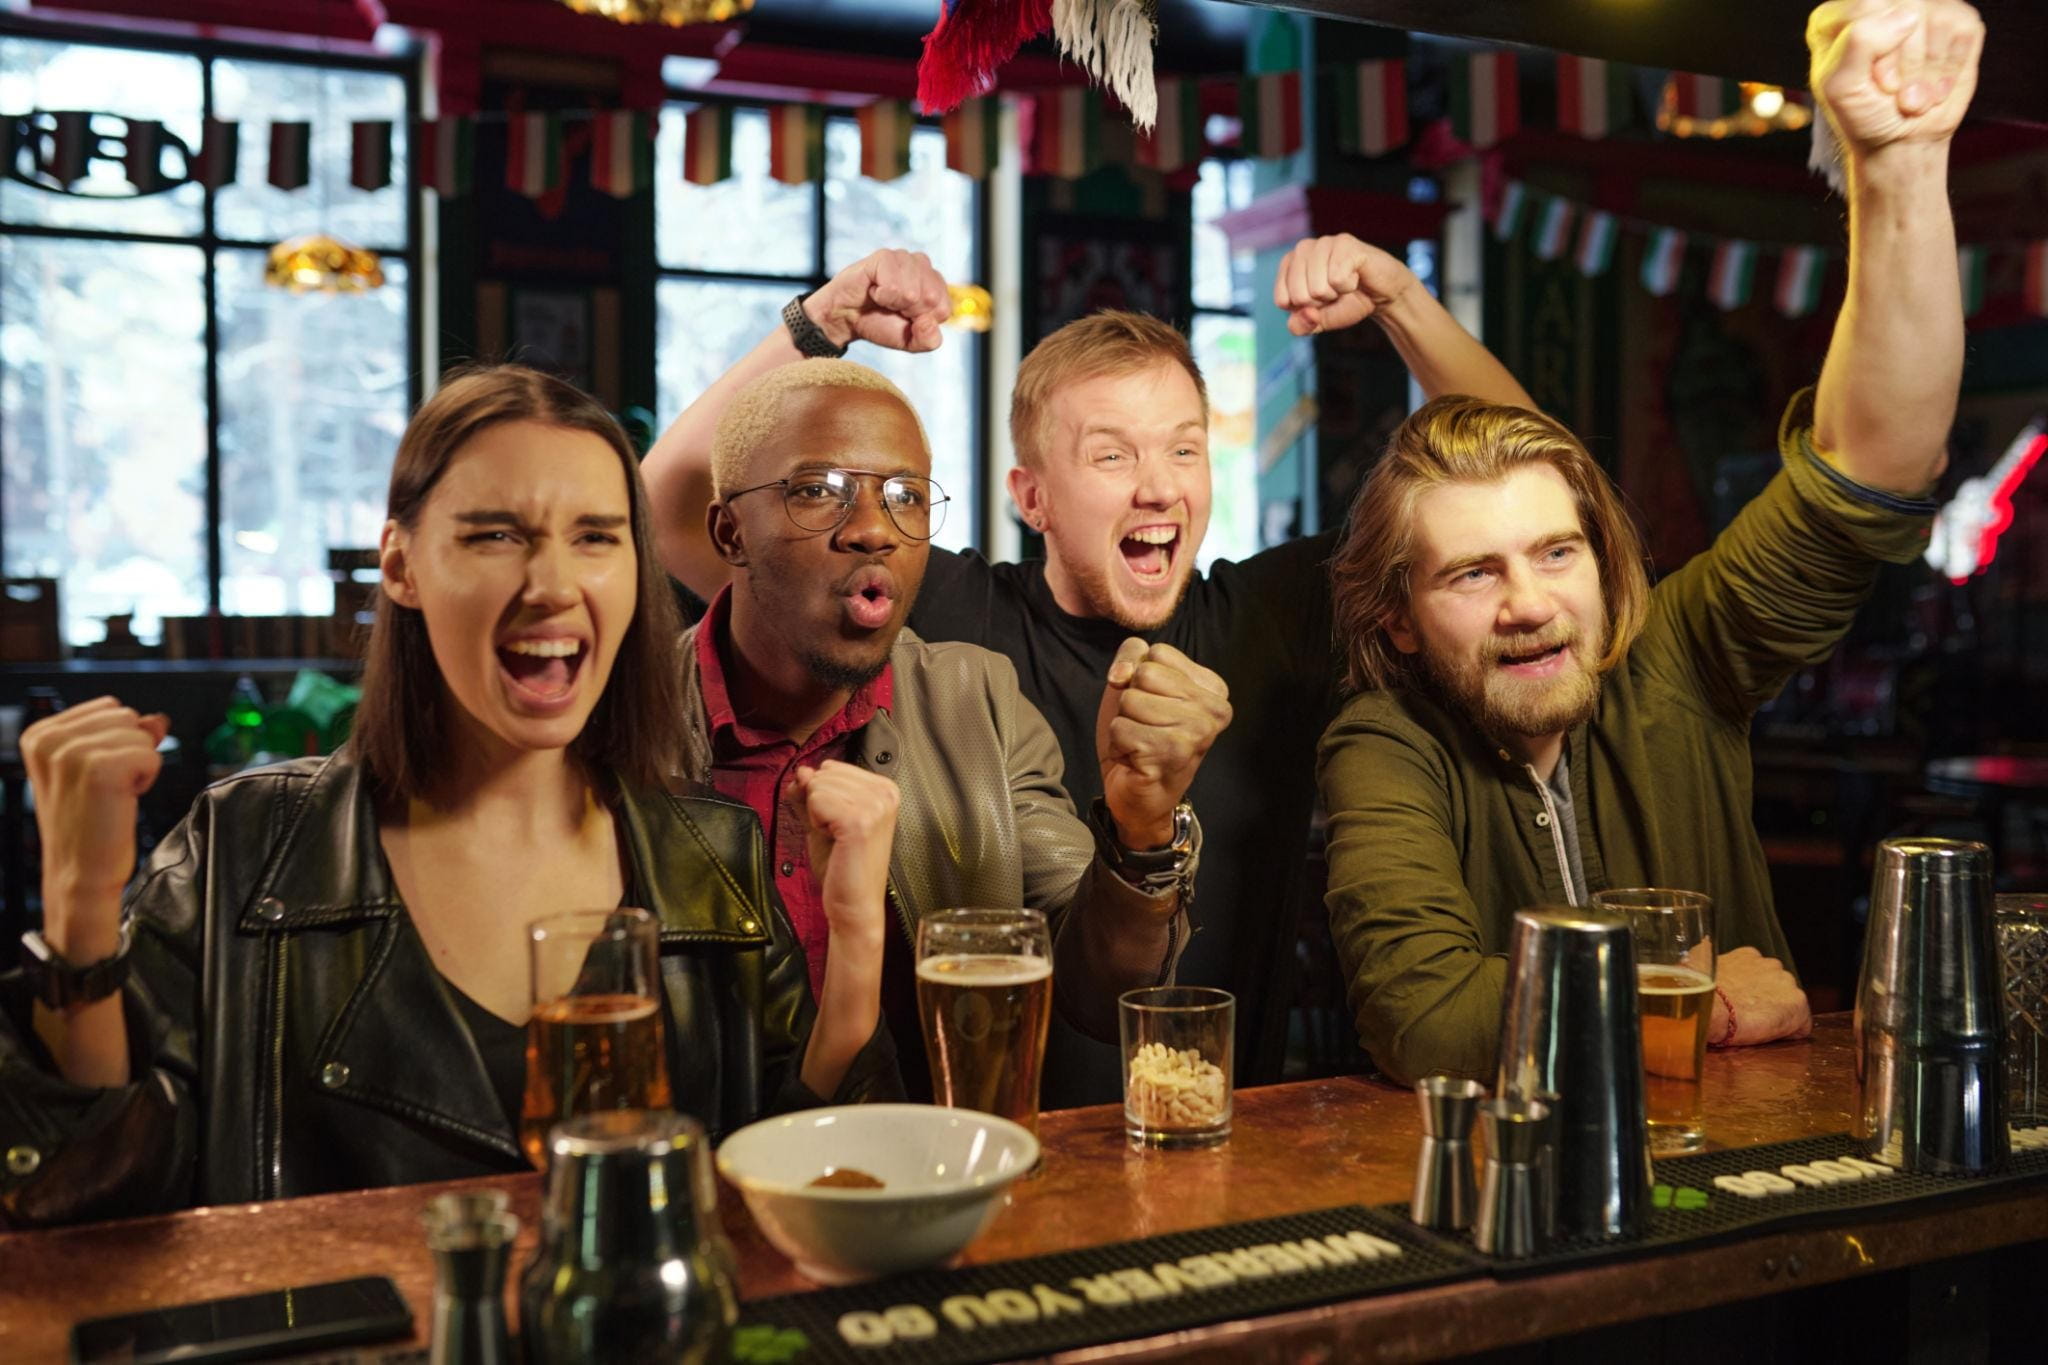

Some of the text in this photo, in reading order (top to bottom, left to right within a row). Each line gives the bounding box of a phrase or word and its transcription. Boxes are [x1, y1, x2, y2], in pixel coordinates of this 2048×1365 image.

[1713, 1155, 1895, 1198] YOU GO
[837, 1231, 1403, 1347] WHEREVER YOU GO
